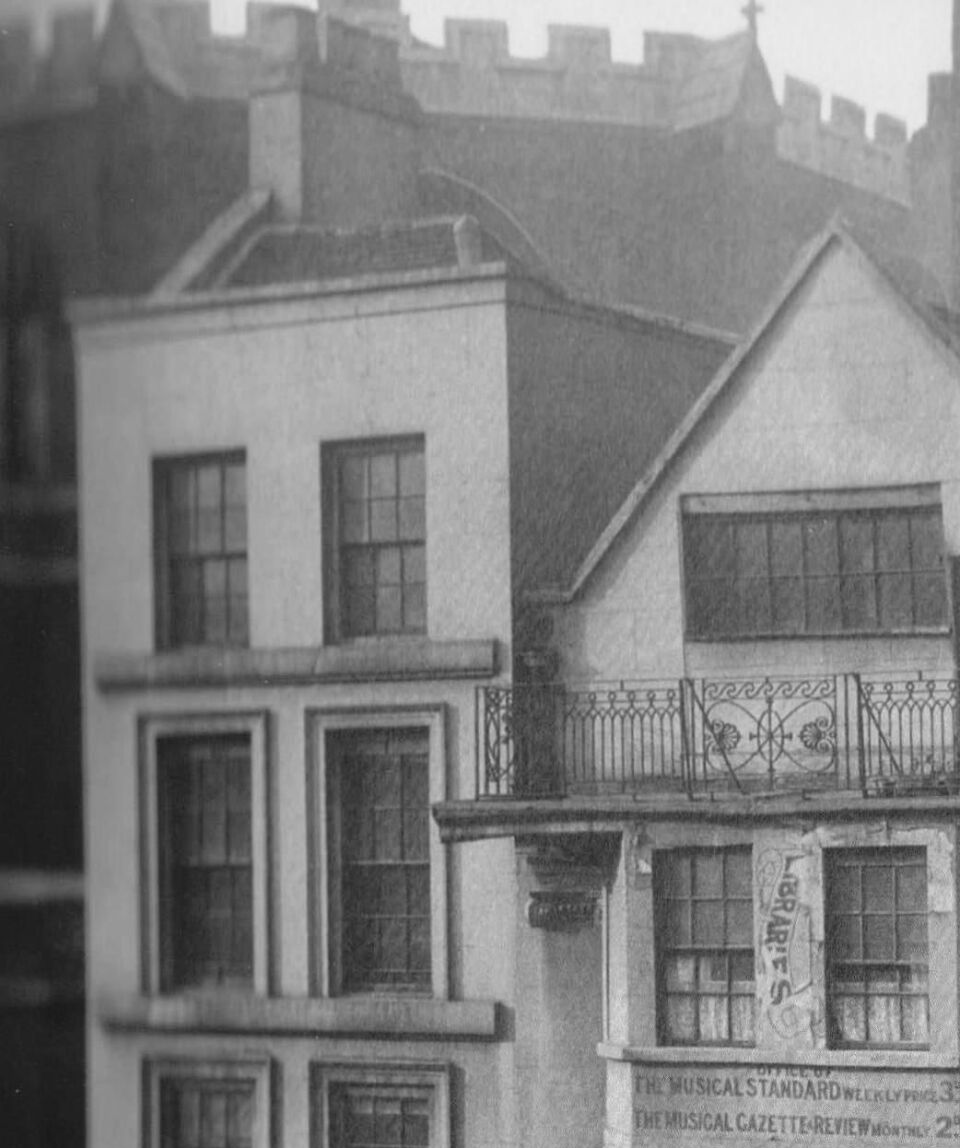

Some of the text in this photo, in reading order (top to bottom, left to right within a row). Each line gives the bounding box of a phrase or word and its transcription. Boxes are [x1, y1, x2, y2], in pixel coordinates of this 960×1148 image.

[635, 1076, 664, 1096] THE
[670, 1077, 743, 1099] MUSICAL
[746, 1079, 840, 1102] STANDARD
[634, 1110, 662, 1130] THE
[664, 1111, 733, 1132] MUSICAL
[735, 1112, 807, 1134] GAZETTE
[814, 1115, 870, 1137] REVIEW
